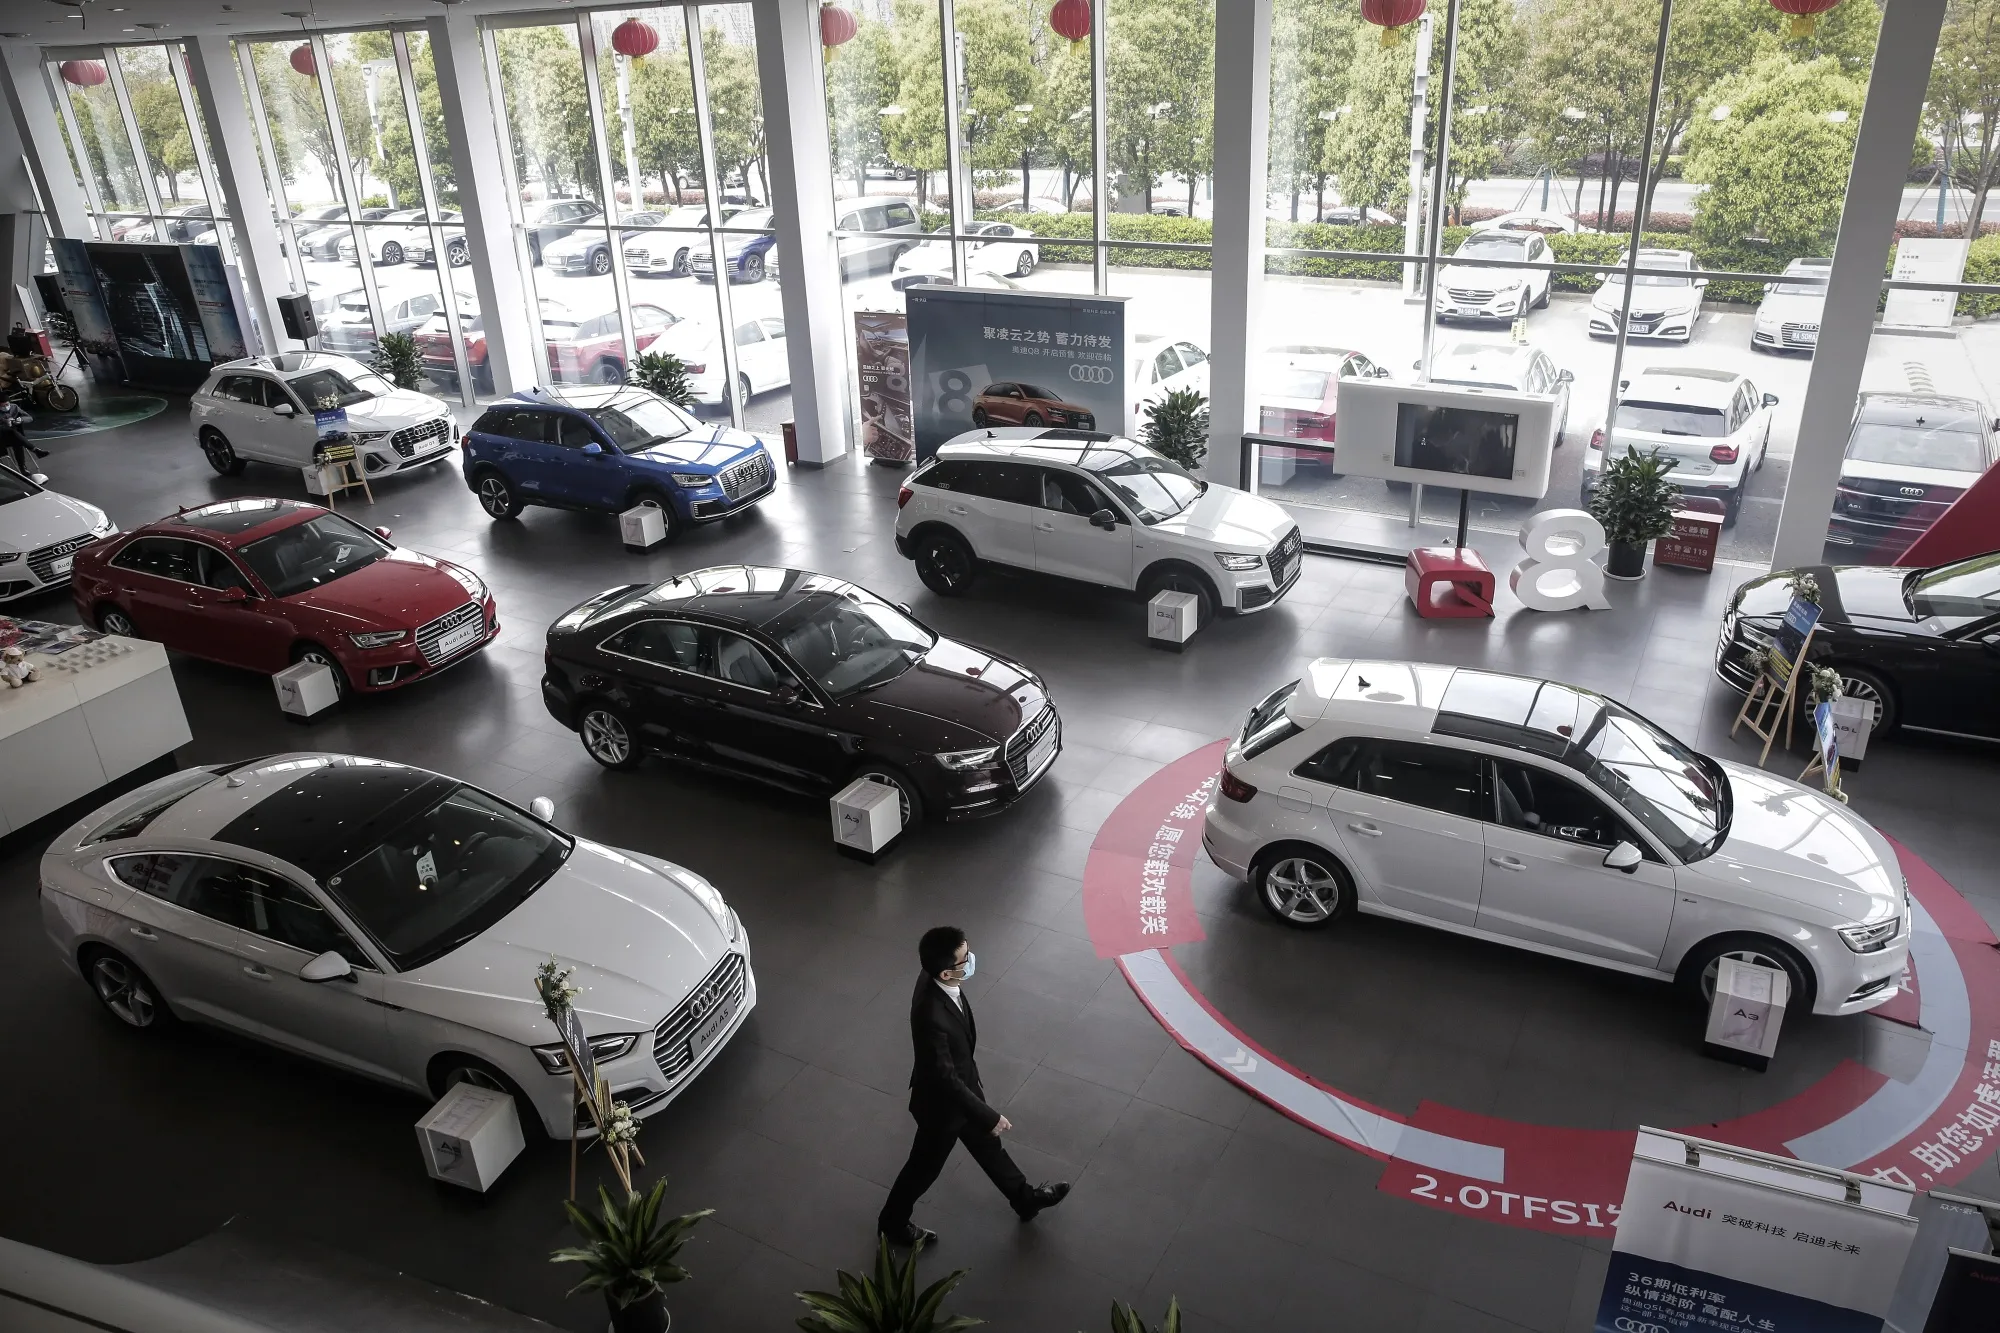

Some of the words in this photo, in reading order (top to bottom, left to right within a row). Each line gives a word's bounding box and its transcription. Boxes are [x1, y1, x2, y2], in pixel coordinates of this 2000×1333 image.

[983, 326, 1050, 343] 聚凌云之势
[1055, 332, 1112, 349] 蓄力待发
[1693, 548, 1708, 557] 119
[444, 635, 459, 647] Audi
[701, 1020, 718, 1045] Audi
[719, 1008, 729, 1025] A5
[1733, 1008, 1760, 1021] A3
[1662, 1200, 1712, 1220] Audi
[1721, 1213, 1787, 1239] 突破科技
[1792, 1231, 1862, 1256] 启迪未来
[1627, 1272, 1727, 1304] 36期低利率
[1624, 1283, 1697, 1311] 纵情进阶
[1702, 1303, 1776, 1332] 高配人生
